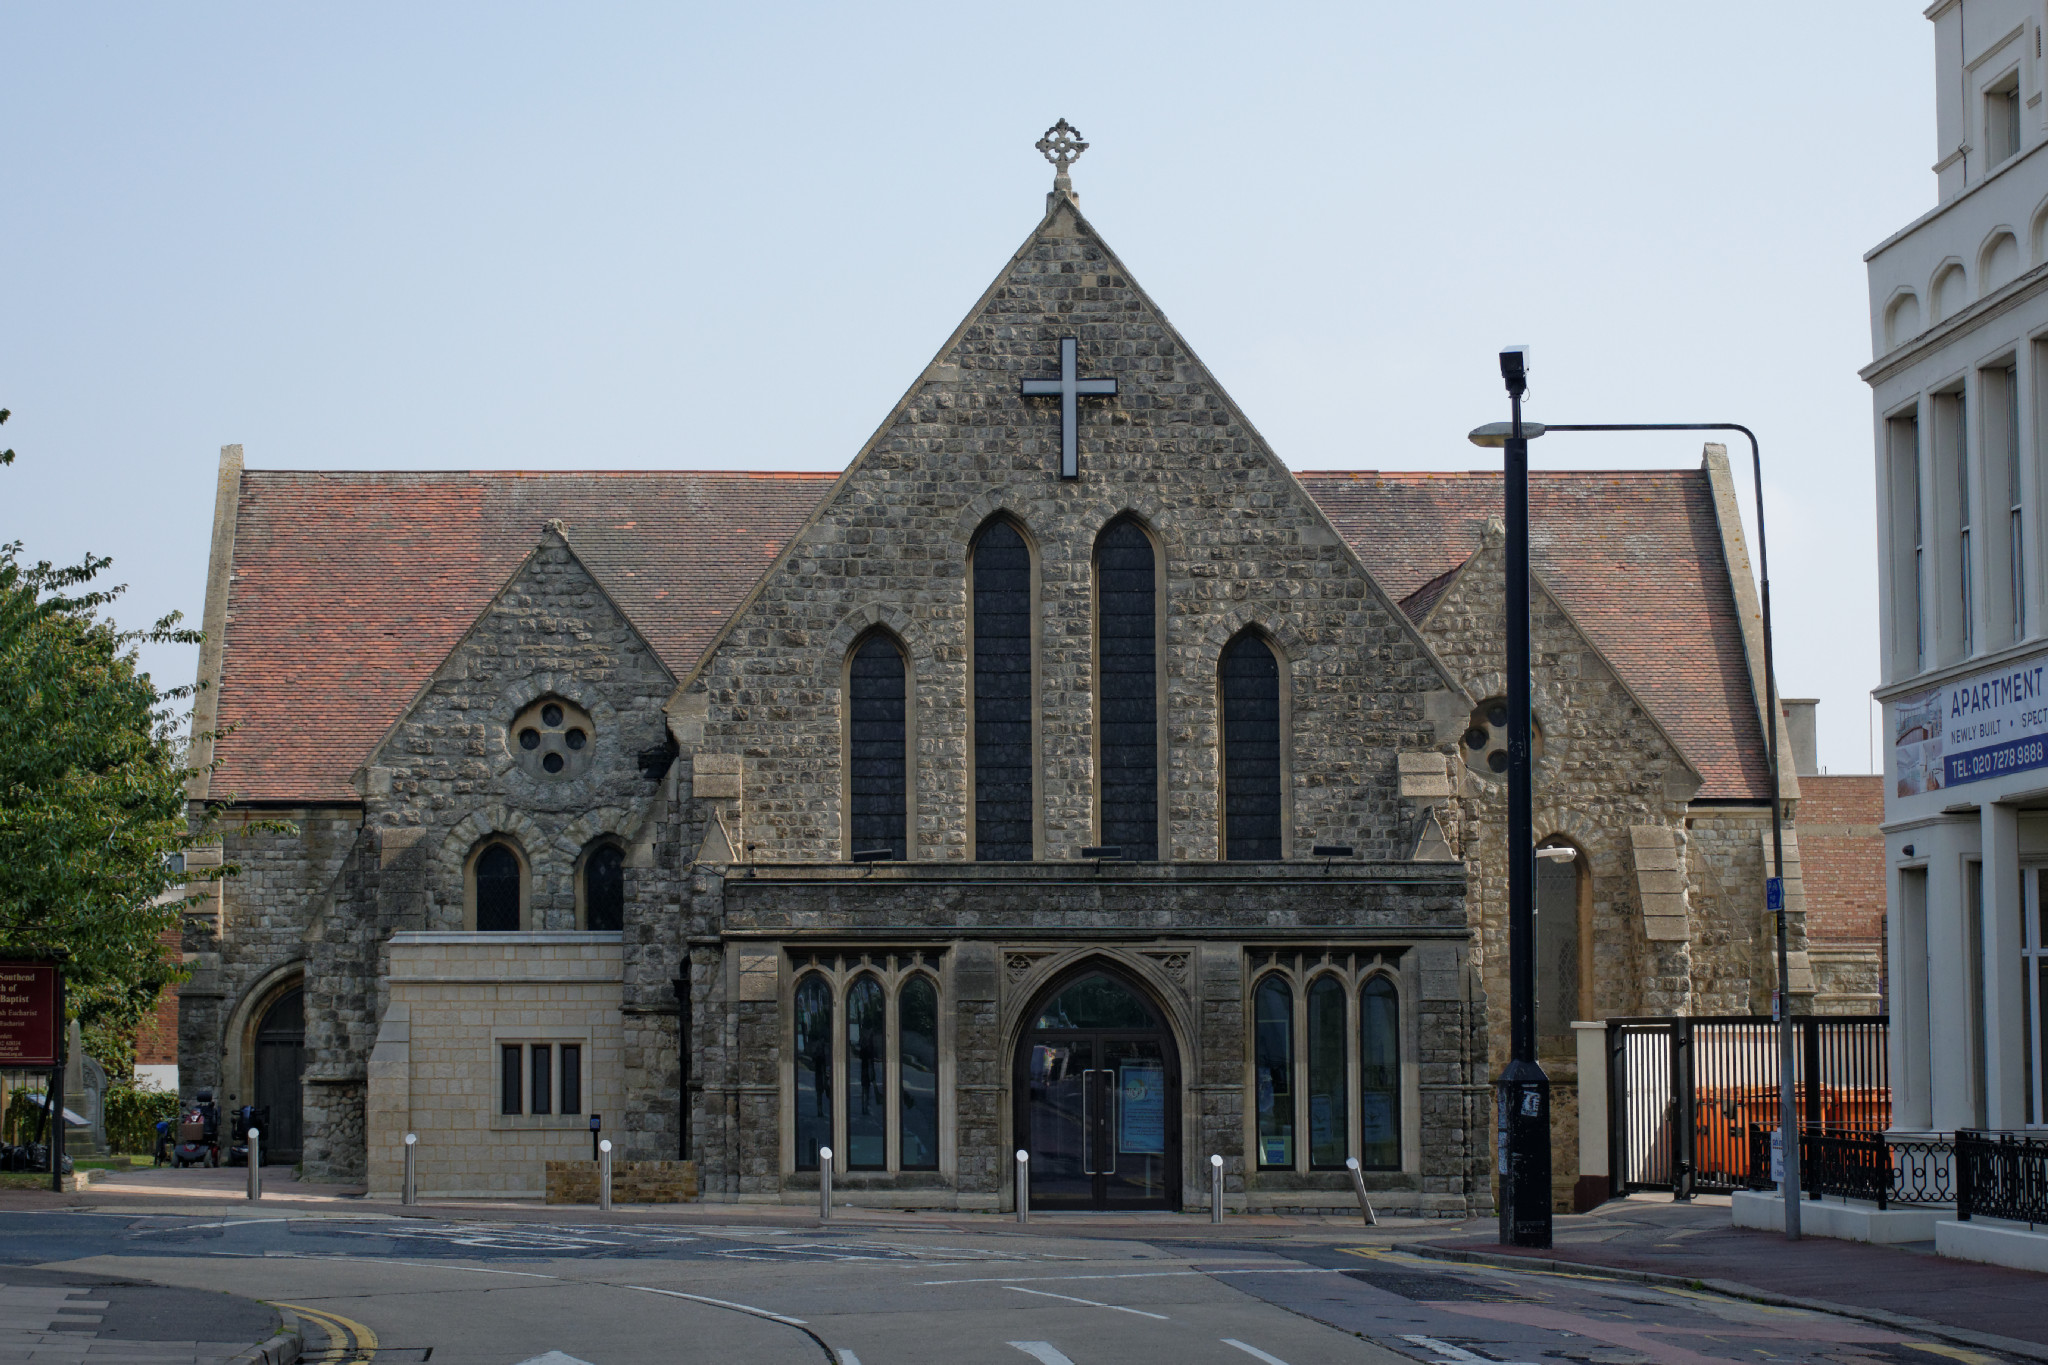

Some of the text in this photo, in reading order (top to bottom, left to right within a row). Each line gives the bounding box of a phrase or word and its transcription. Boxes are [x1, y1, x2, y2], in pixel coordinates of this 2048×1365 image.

[1951, 667, 2043, 719] APARTMENT
[1951, 707, 2048, 745] NEWLY BUILT SPECT
[1952, 741, 2044, 779] TEL: 020 7278 9888
[0, 994, 29, 1004] Baptist
[8, 984, 17, 992] of
